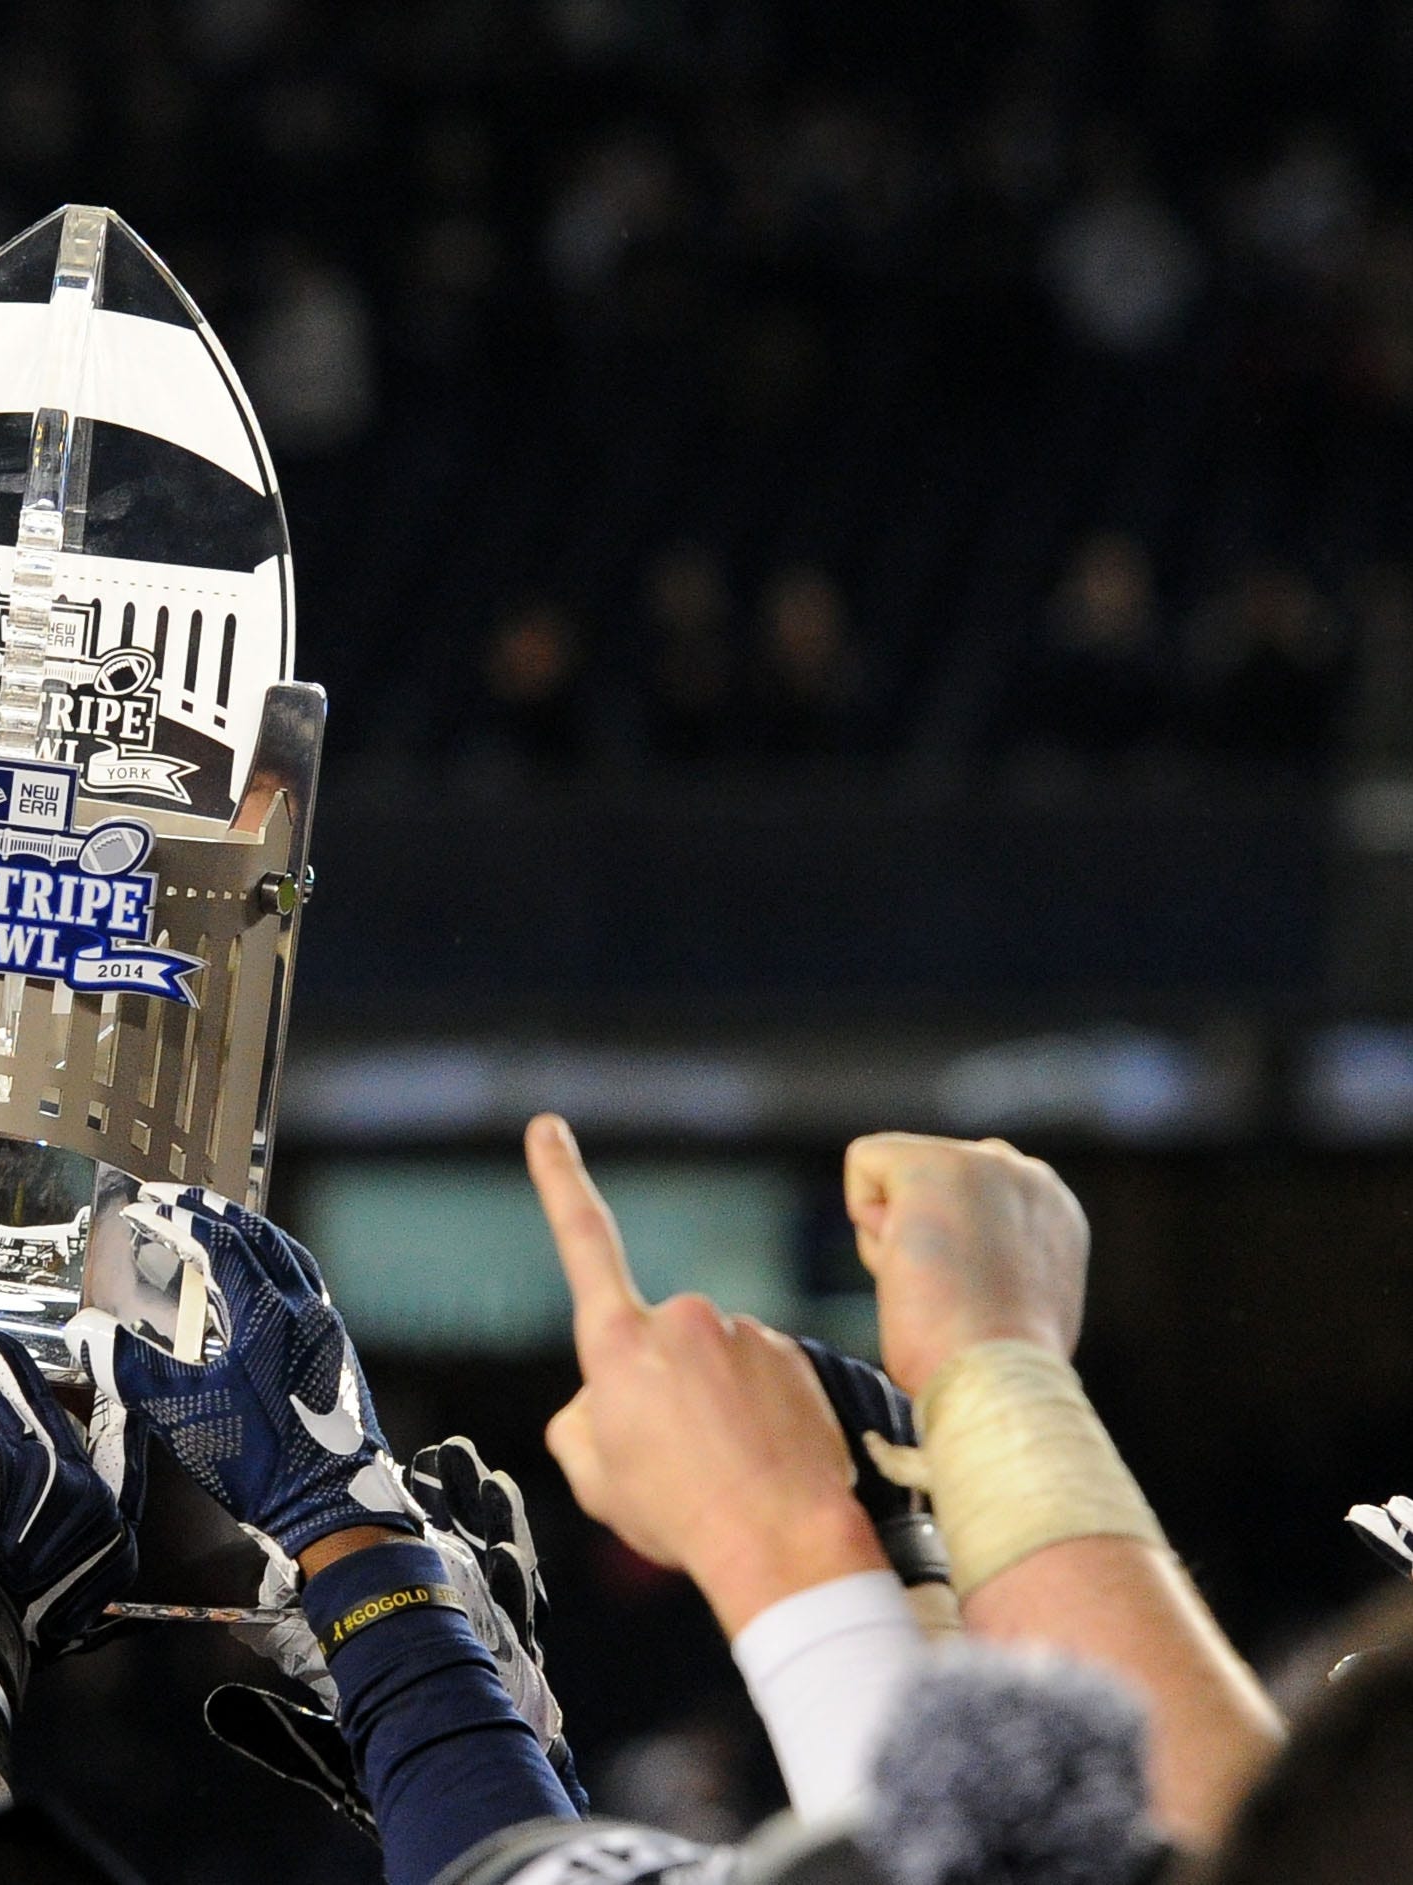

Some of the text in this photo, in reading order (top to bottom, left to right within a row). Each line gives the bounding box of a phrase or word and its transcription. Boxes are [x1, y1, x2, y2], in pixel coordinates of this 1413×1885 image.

[47, 622, 77, 635] NEW
[107, 767, 151, 781] YORK
[20, 782, 60, 801] NEW
[19, 799, 58, 817] ERA
[97, 963, 144, 979] 2014
[343, 1588, 429, 1632] #GOGOLD
